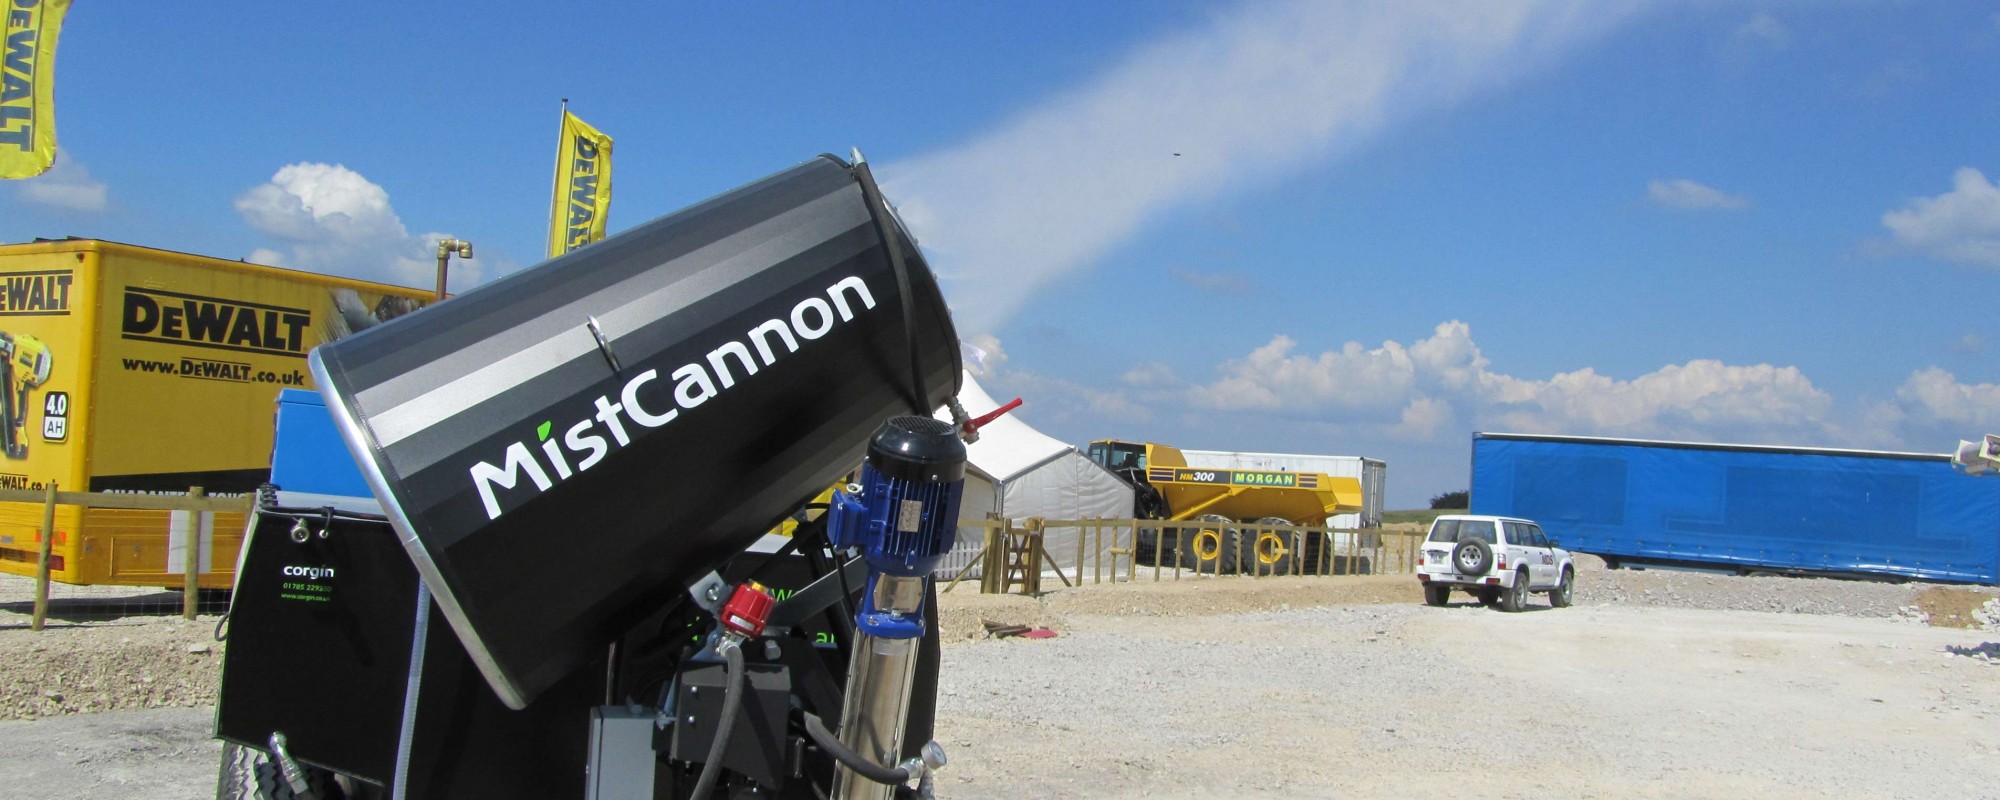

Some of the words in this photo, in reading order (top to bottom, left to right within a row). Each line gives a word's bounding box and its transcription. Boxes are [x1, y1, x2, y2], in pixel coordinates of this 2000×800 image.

[122, 292, 310, 352] DEWALT
[46, 394, 67, 416] 4.0
[469, 275, 877, 520] MistCannon
[46, 421, 63, 434] AH
[1235, 473, 1293, 485] MORGAN
[283, 565, 335, 580] corgin
[283, 582, 305, 590] 01785
